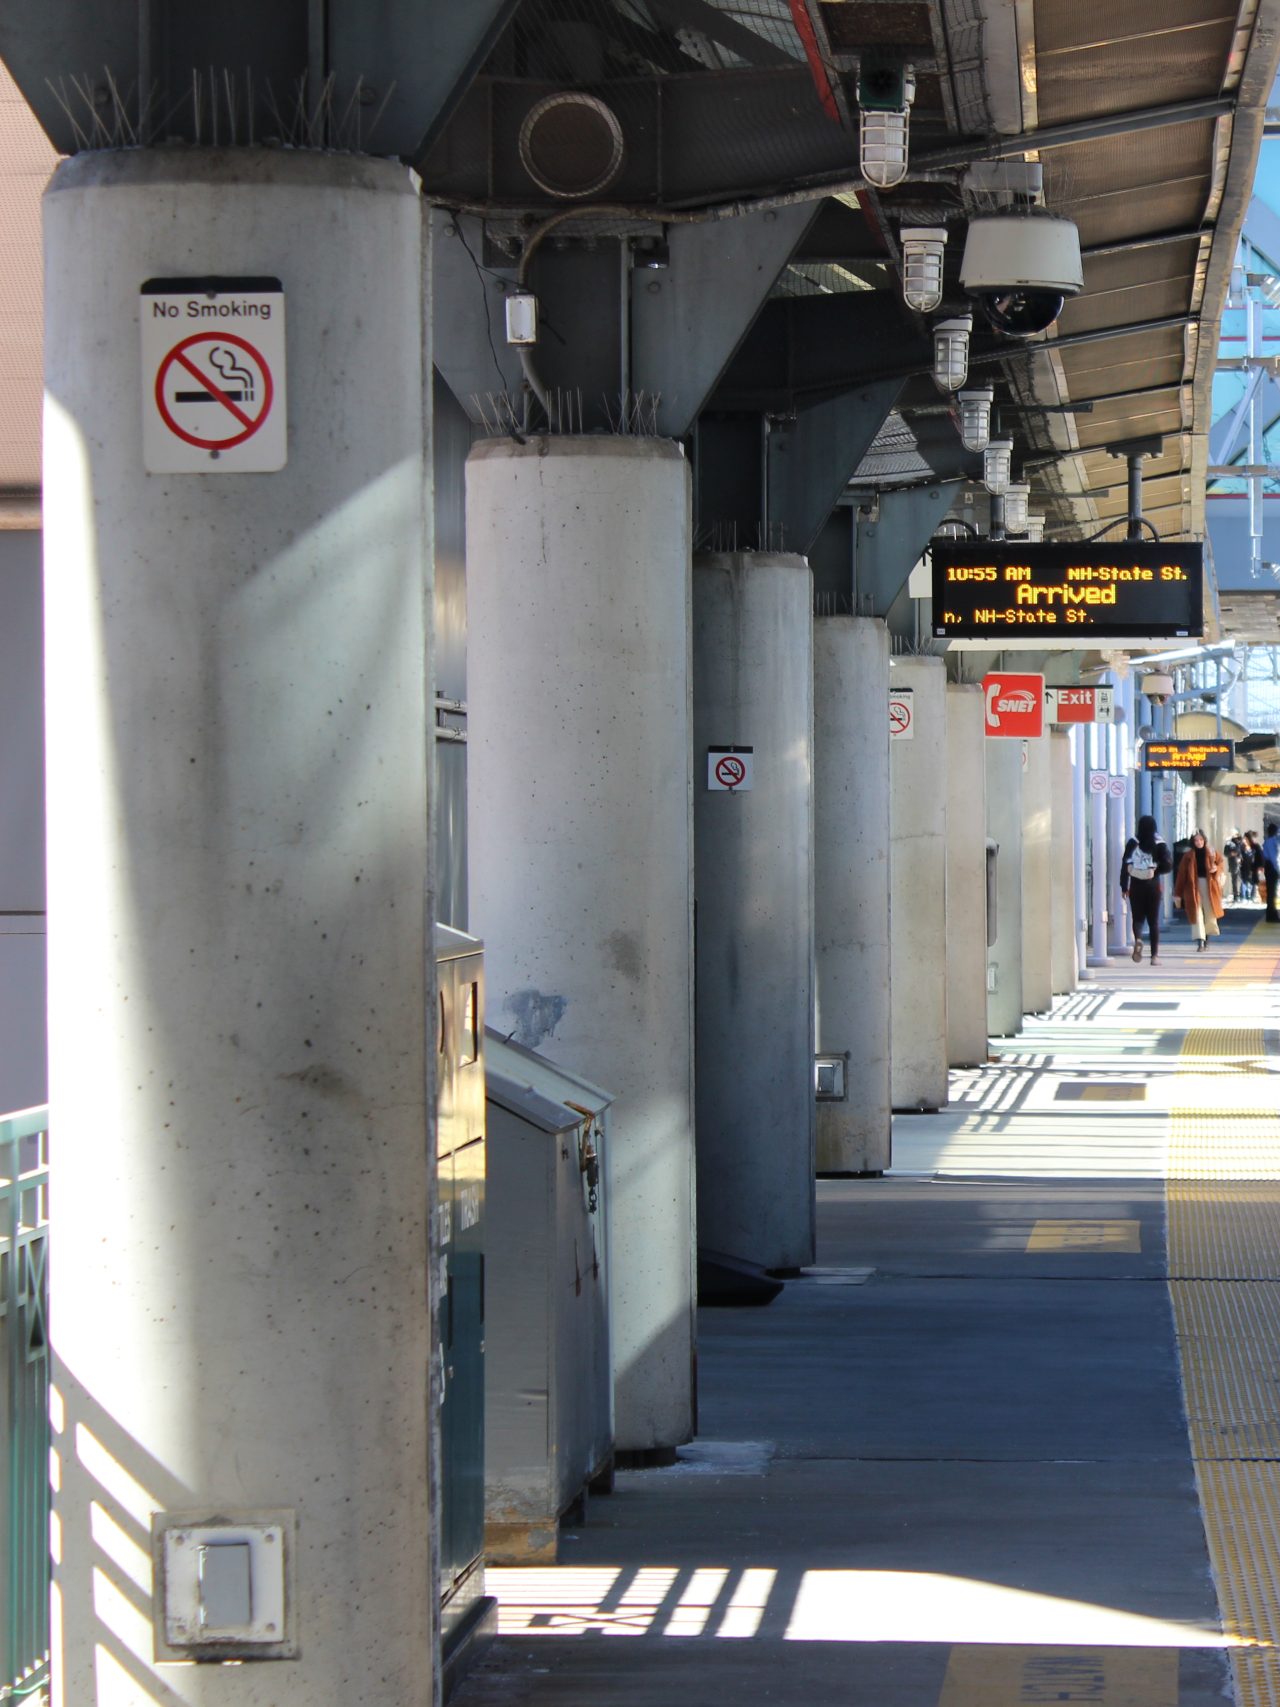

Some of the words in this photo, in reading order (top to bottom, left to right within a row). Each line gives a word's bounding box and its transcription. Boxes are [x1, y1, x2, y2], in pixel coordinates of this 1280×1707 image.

[153, 301, 179, 318] No
[187, 300, 271, 320] Smoking
[947, 567, 997, 581] 10:55
[1005, 567, 1032, 581] AM
[1068, 567, 1153, 581] NH-State
[1161, 567, 1187, 581] St.
[1017, 584, 1116, 605] Arrived
[974, 609, 1057, 624] NH-State
[1066, 609, 1095, 623] St.
[1058, 690, 1092, 705] Exit
[997, 700, 1036, 713] SNET
[1172, 752, 1206, 760] Arrived
